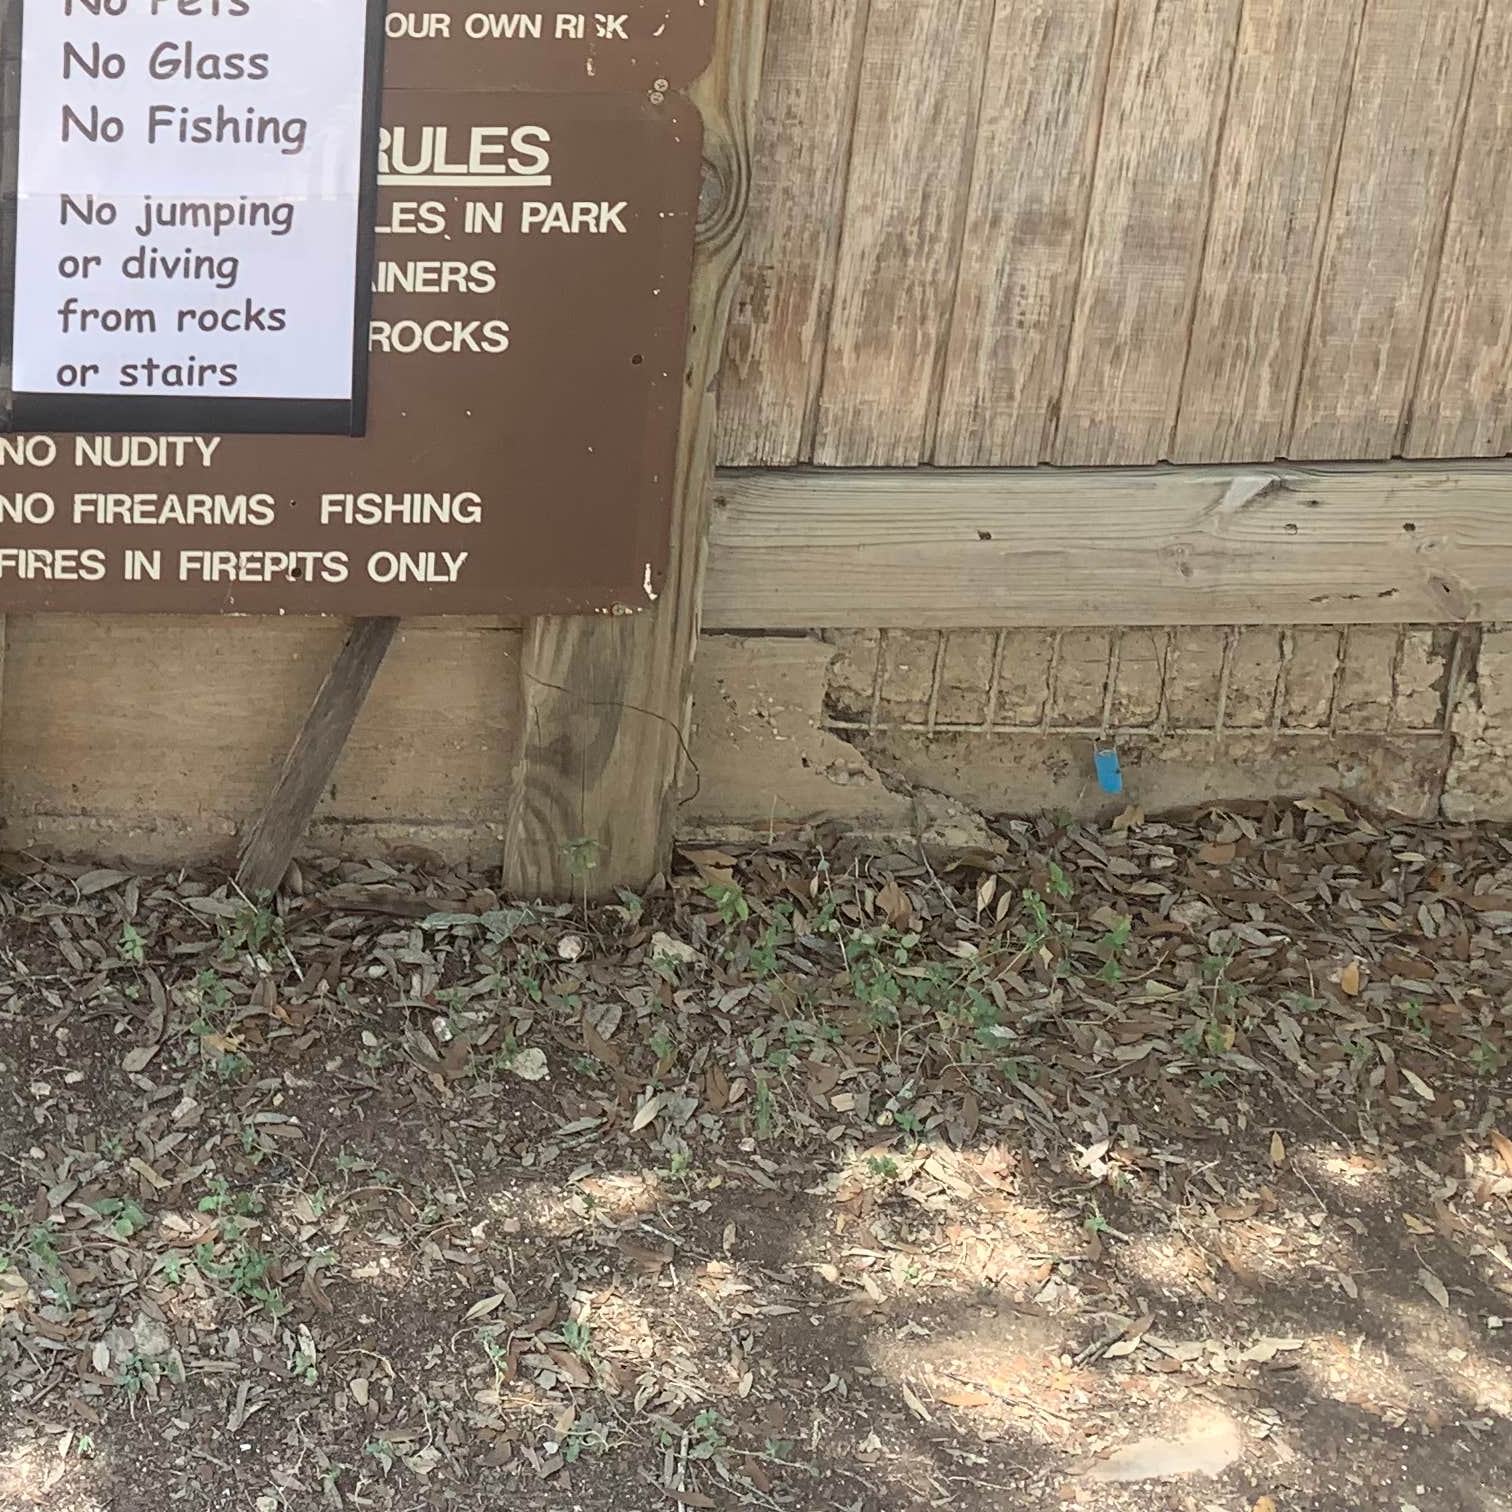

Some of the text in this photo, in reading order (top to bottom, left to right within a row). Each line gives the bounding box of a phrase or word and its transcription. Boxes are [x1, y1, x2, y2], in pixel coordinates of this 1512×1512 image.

[466, 14, 541, 38] OWN
[556, 14, 628, 38] RISK
[64, 42, 268, 79] No Glass
[63, 105, 306, 154] No Fishing
[379, 126, 550, 174] RULES
[61, 194, 294, 236] No jumping
[465, 202, 502, 232] IN
[522, 202, 626, 232] PARK
[59, 246, 238, 288] or diving
[372, 261, 495, 292] INERS
[58, 298, 285, 332] from rocks
[369, 321, 508, 352] ROCKS
[57, 356, 237, 386] or stairs
[76, 437, 220, 466] NUDITY
[74, 494, 274, 525] FIREARMS
[321, 493, 481, 524] FISHING
[125, 551, 160, 579] IN
[180, 551, 348, 582] FIREPITS
[368, 552, 467, 582] ONLY
